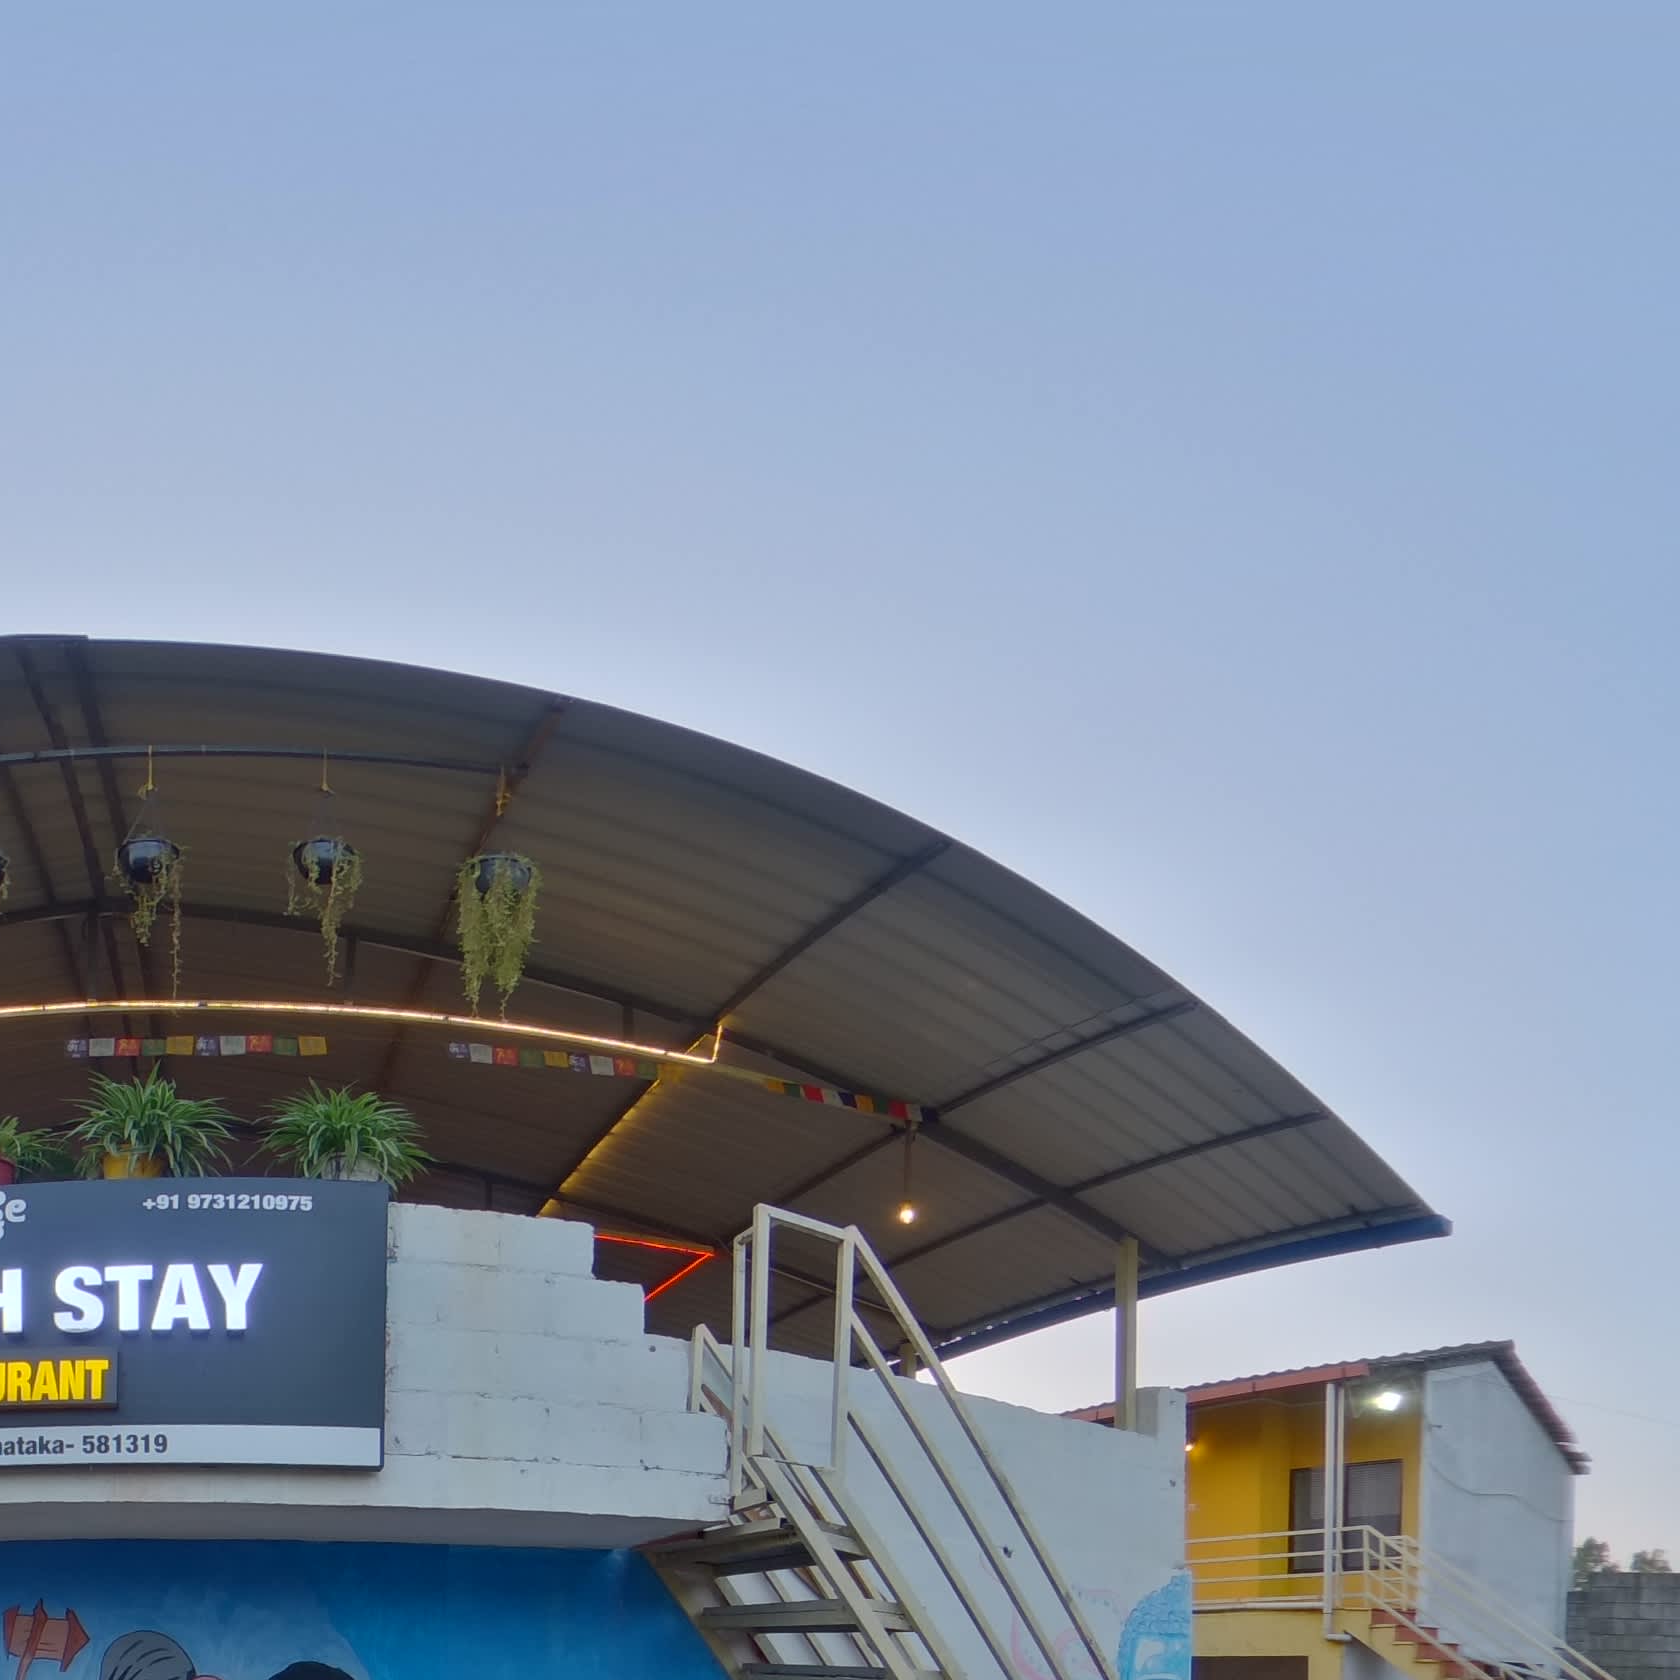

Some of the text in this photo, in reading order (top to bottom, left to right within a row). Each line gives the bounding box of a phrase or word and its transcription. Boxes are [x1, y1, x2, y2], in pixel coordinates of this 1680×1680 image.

[142, 1193, 313, 1212] +91 9731210975
[52, 1263, 265, 1334] STAY
[81, 1434, 168, 1455] 581319
